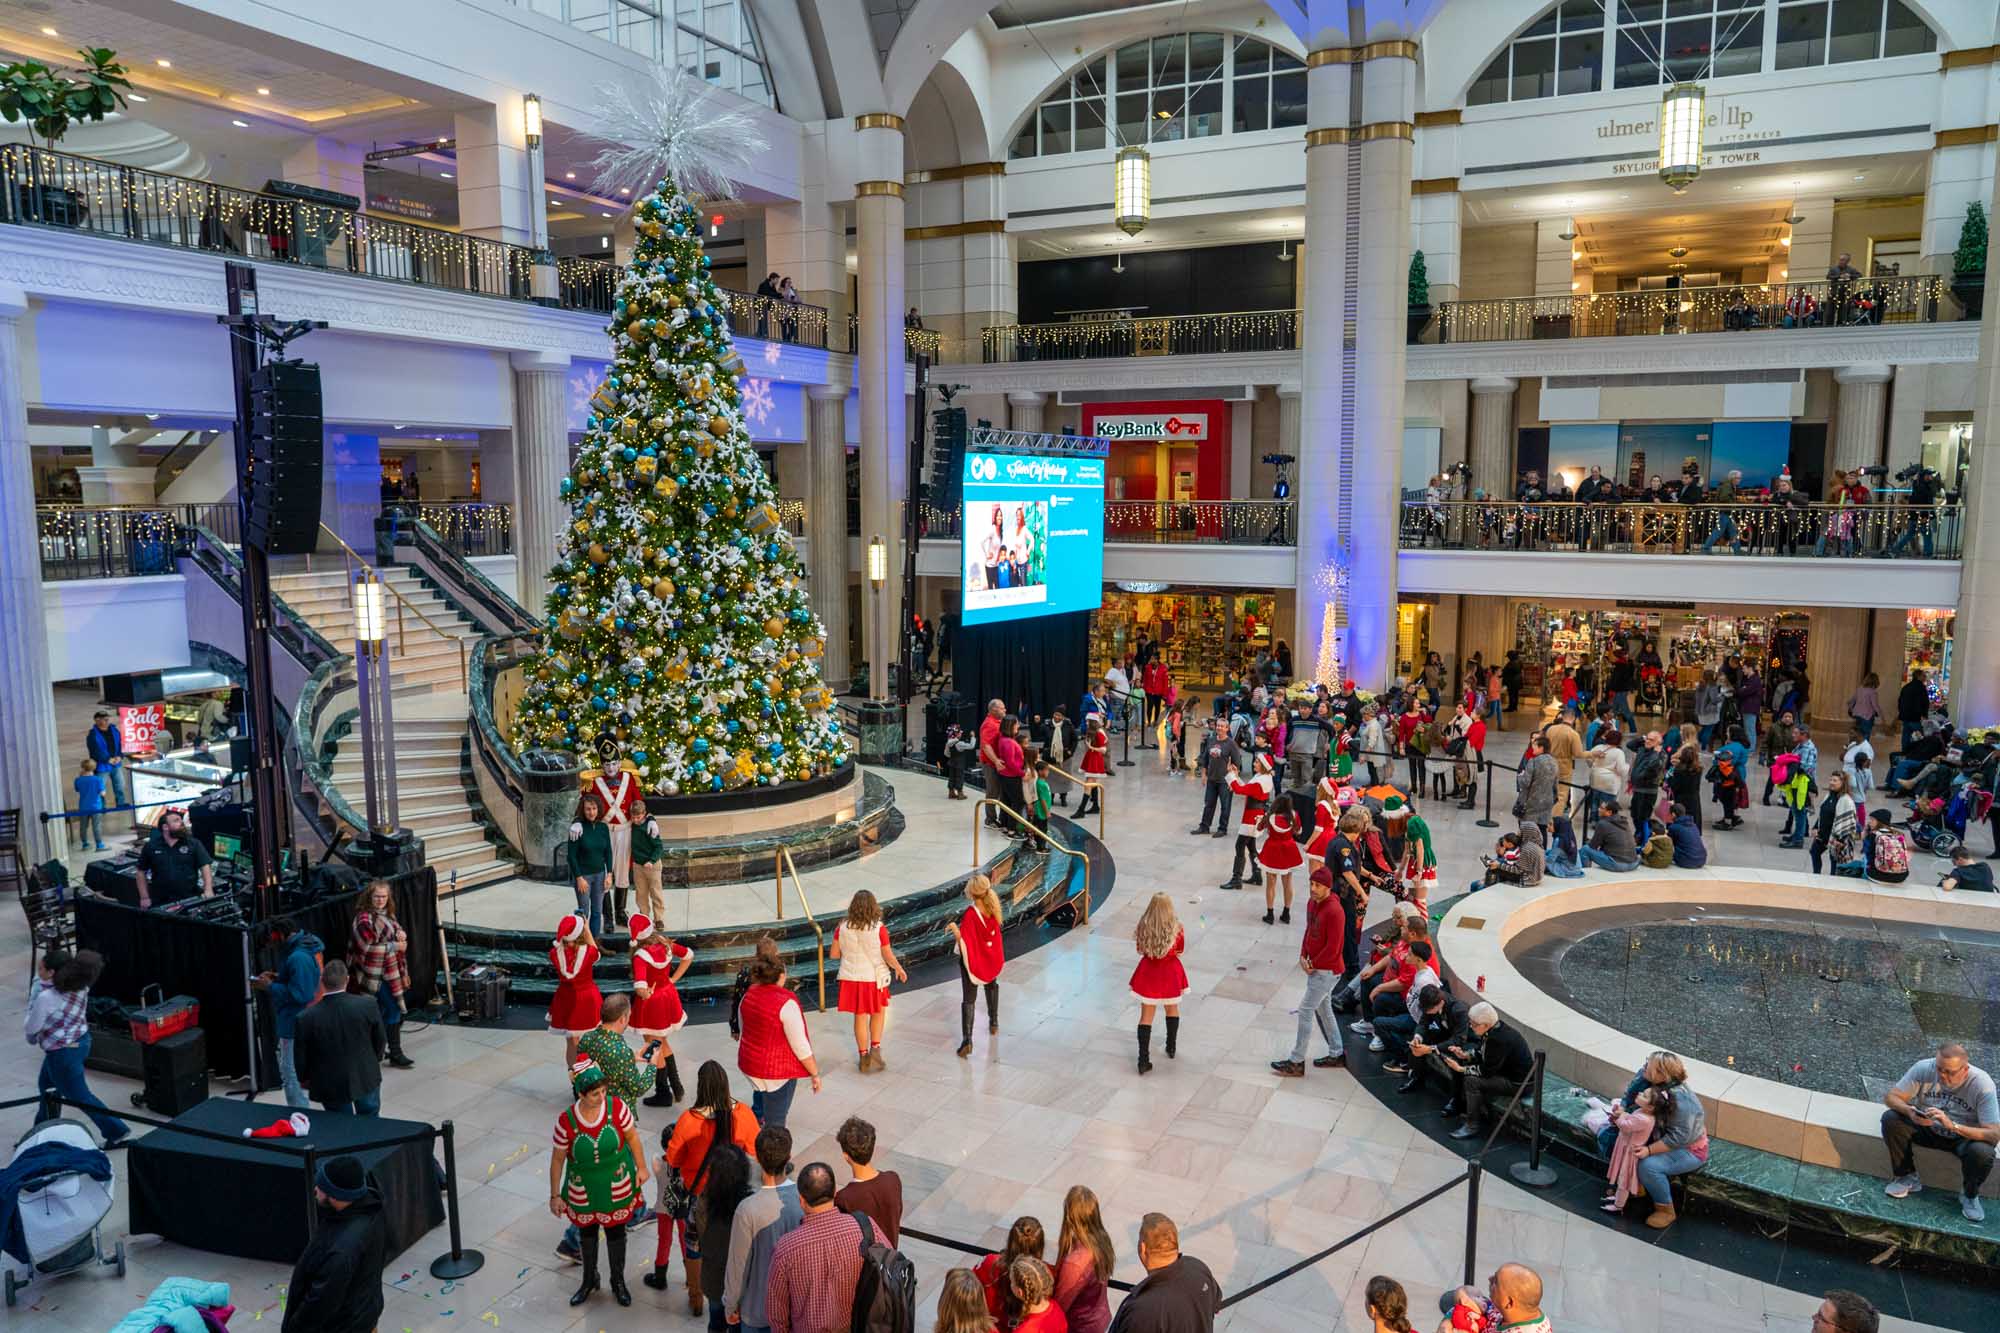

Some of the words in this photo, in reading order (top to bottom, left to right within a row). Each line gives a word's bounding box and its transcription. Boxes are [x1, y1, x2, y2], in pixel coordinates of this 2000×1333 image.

[1597, 119, 1655, 138] ulmer
[1727, 106, 1753, 130] llp
[1720, 130, 1781, 143] ATTORNEYS
[1613, 161, 1660, 173] SKYLIGH
[1720, 152, 1761, 164] TOWER
[1097, 420, 1165, 439] KeyBank
[124, 705, 161, 727] Sale
